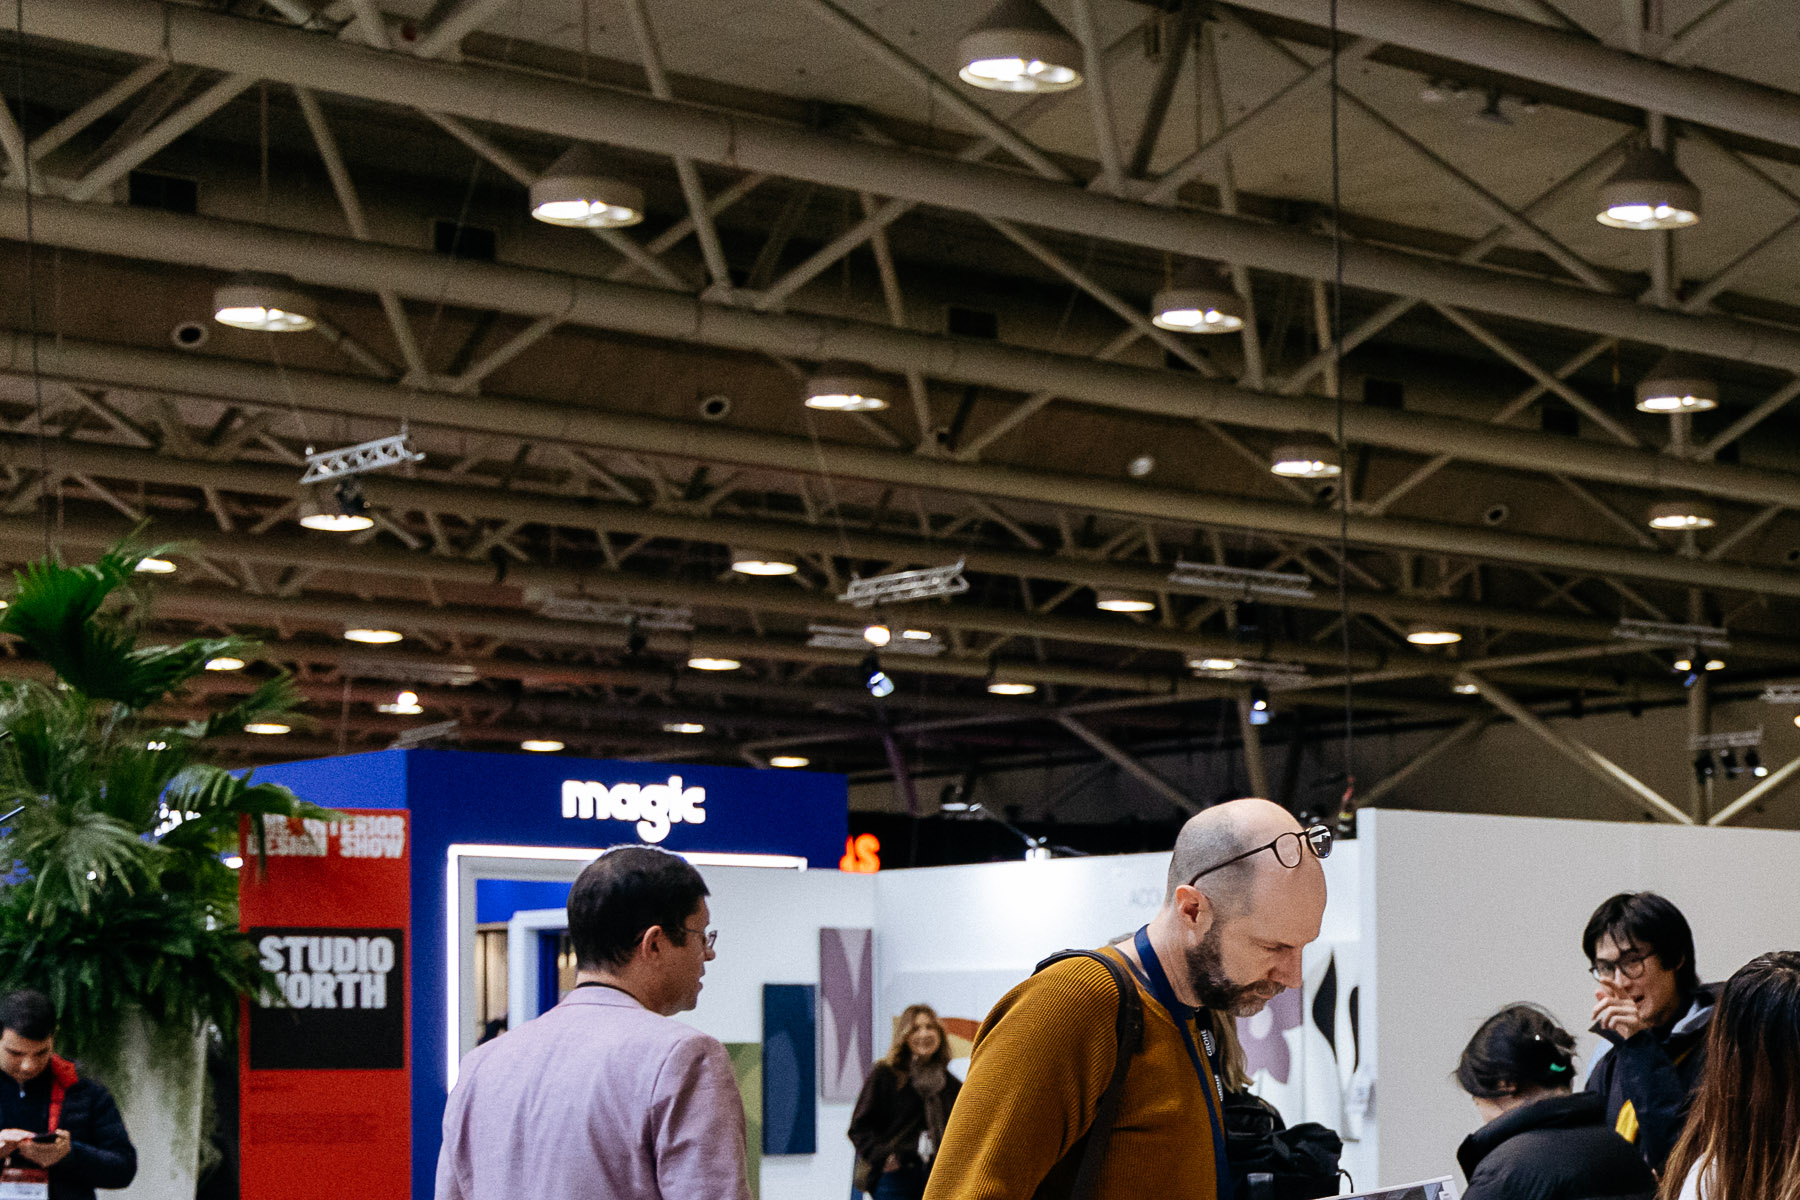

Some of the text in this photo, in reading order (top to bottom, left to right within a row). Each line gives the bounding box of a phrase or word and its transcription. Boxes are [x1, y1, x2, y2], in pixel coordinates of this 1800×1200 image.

[562, 775, 705, 843] magic
[340, 837, 404, 858] SHOW
[258, 935, 395, 973] STUDIO
[1200, 1029, 1213, 1057] GROHE
